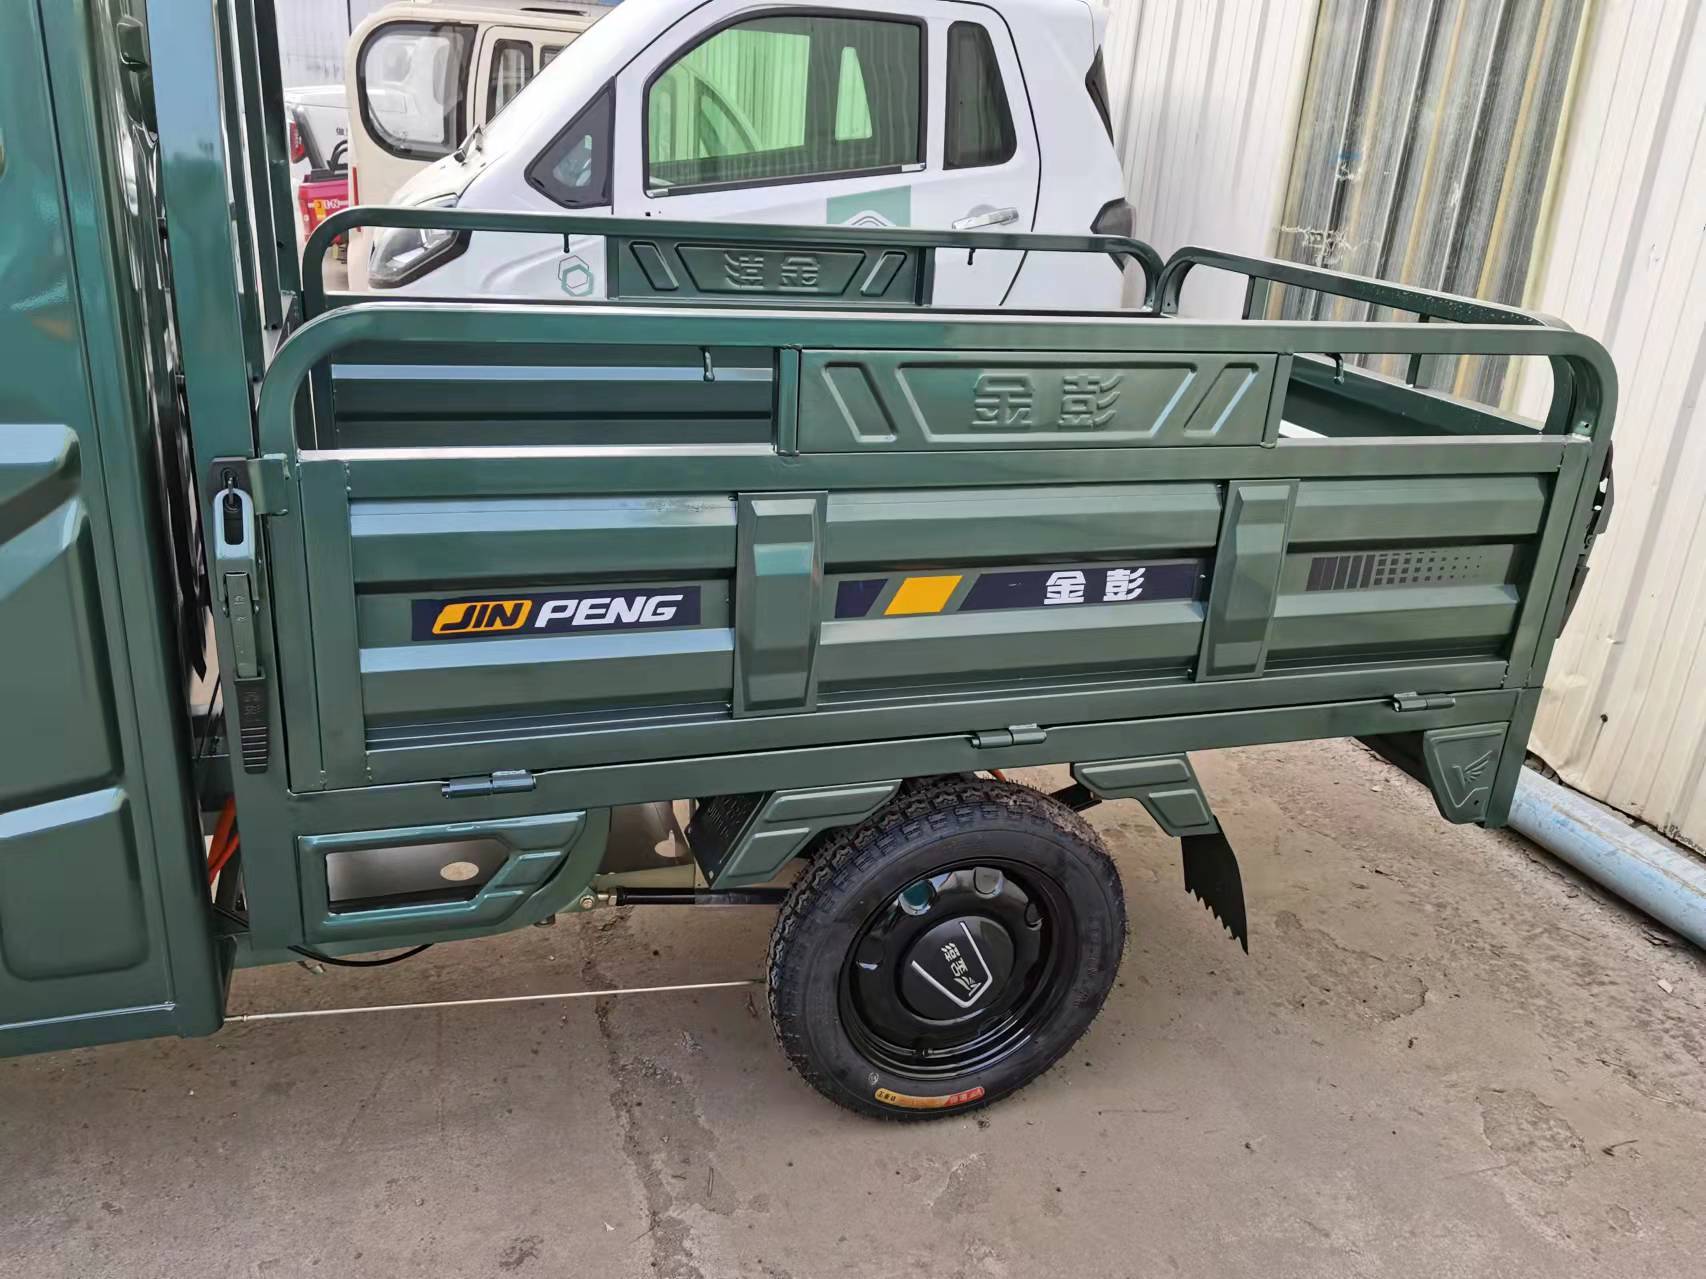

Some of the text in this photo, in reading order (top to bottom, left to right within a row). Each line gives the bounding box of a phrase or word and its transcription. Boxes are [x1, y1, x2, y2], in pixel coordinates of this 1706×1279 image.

[971, 373, 1122, 429] 金彭
[1044, 567, 1146, 605] 金彭
[433, 594, 684, 634] JIN PENG
